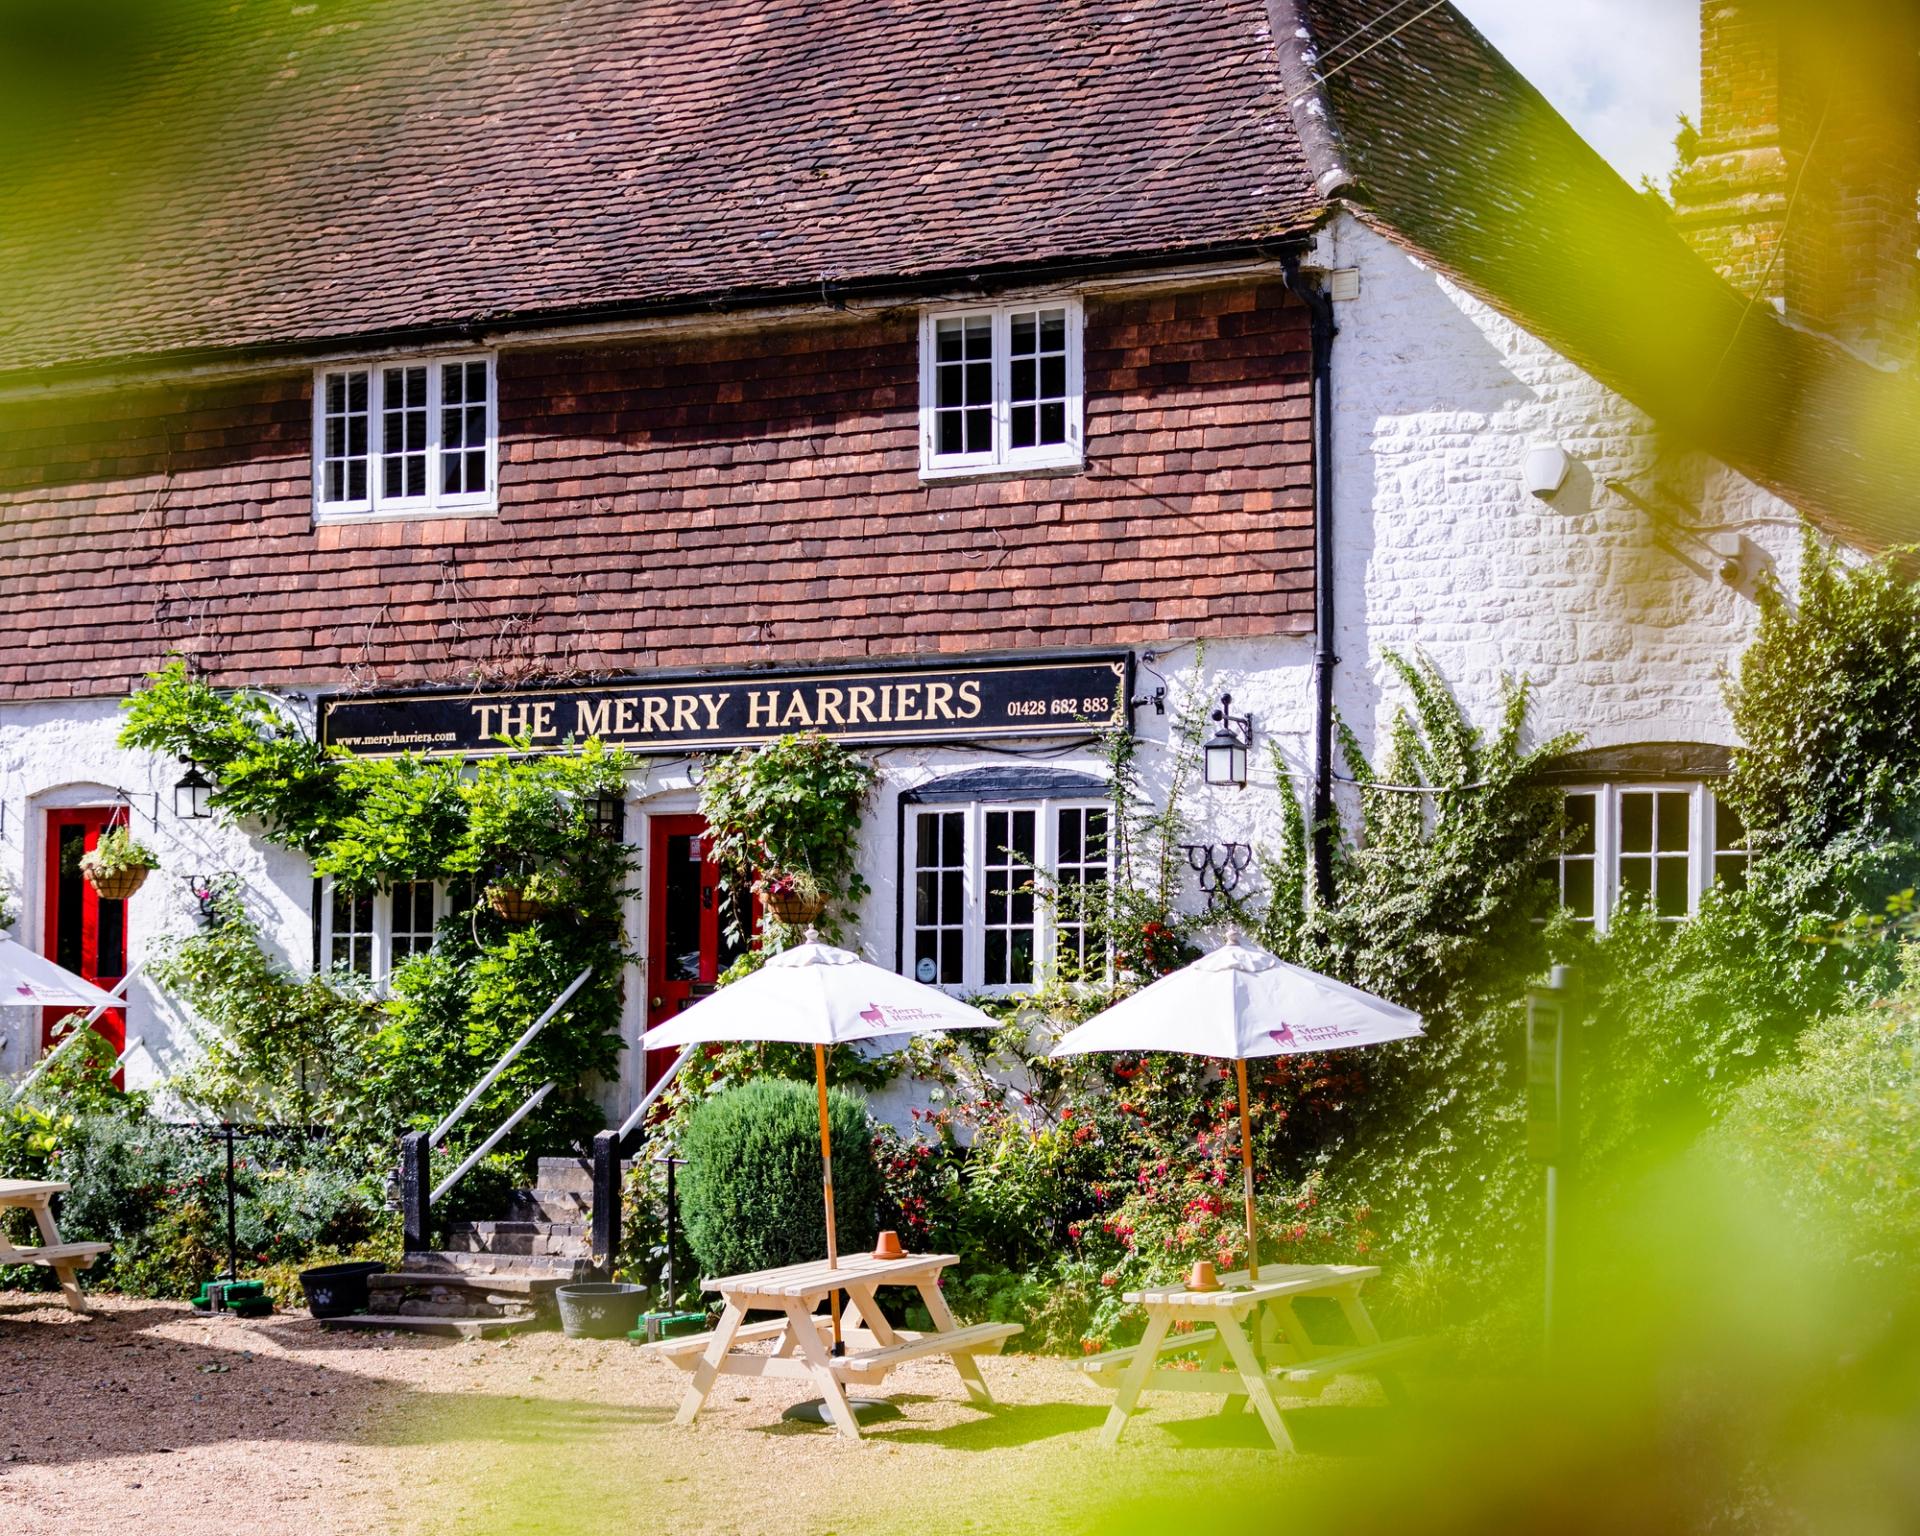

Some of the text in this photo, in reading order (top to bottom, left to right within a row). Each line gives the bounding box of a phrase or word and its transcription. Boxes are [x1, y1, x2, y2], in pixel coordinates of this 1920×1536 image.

[471, 681, 981, 740] THE MERRY HARRIERS
[1007, 697, 1109, 716] 01428 682 883
[336, 731, 456, 746] www.merryharriers.com
[1298, 1024, 1338, 1035] Merry
[1303, 1029, 1359, 1042] Harriers
